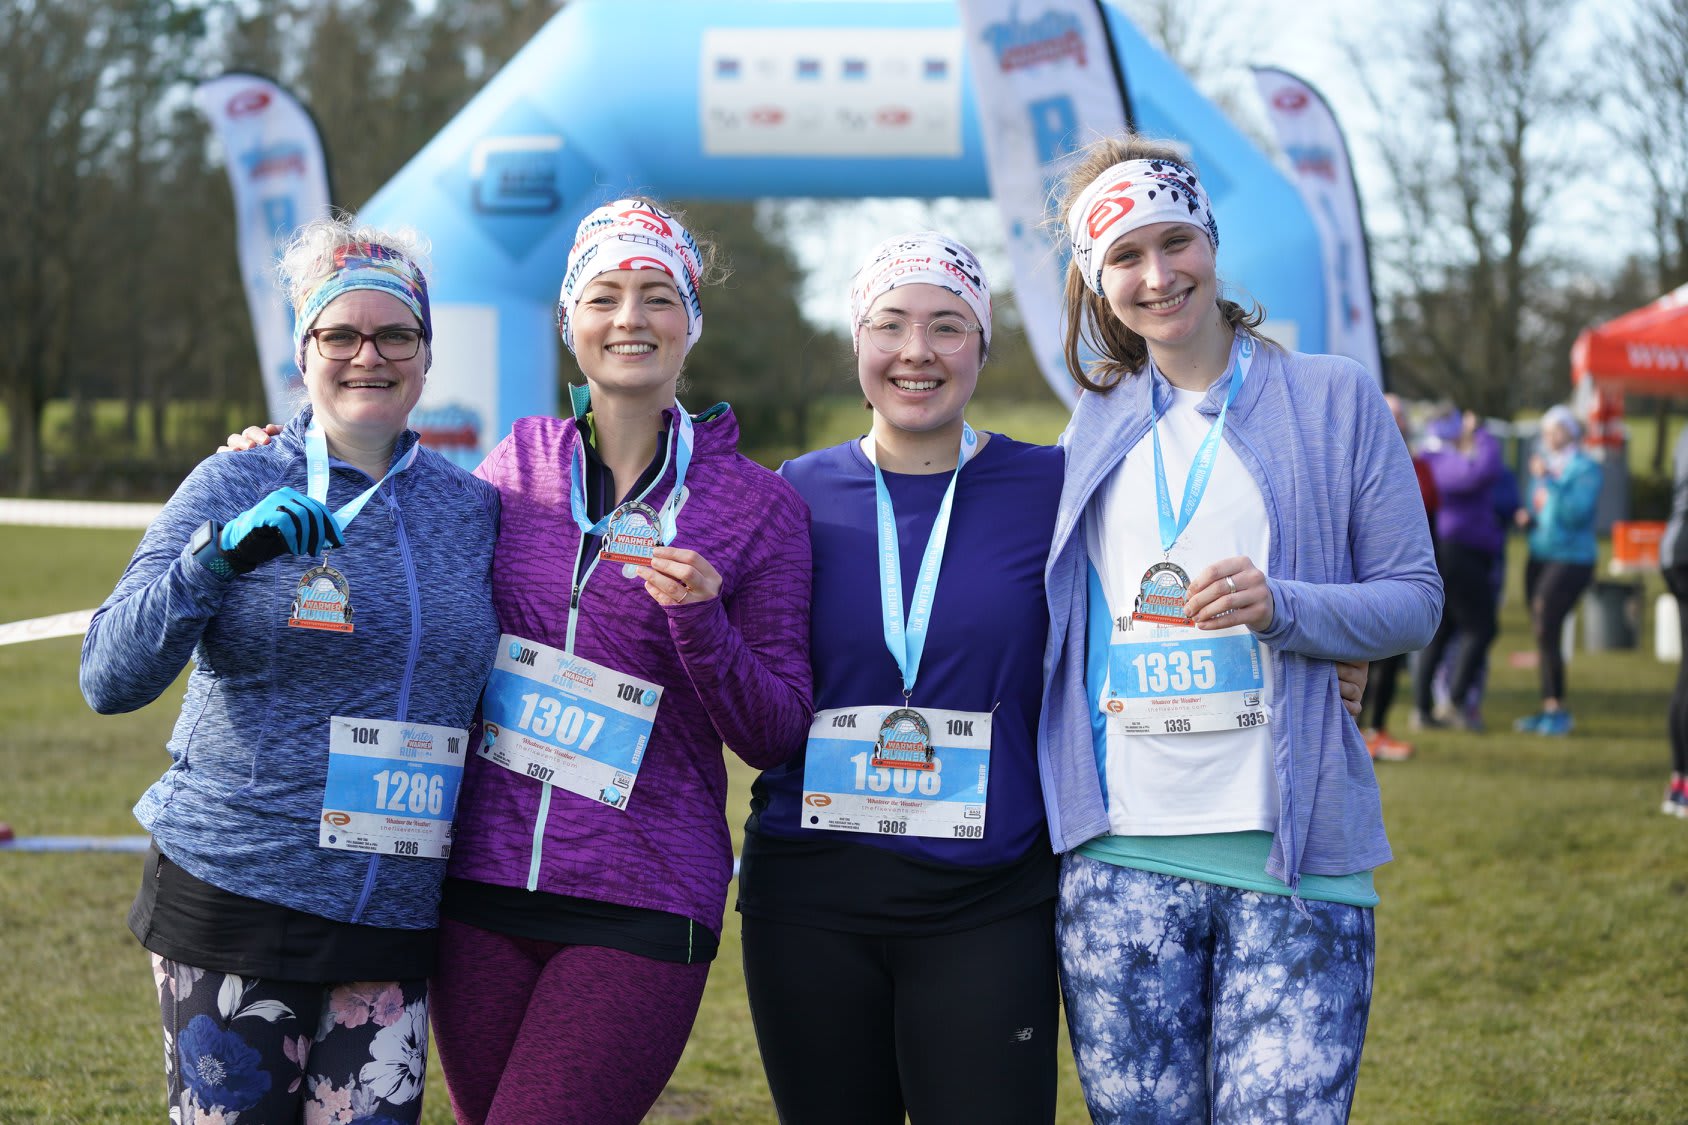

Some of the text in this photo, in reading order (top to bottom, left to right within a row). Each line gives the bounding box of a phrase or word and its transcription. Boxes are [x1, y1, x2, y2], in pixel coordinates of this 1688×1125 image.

[617, 535, 654, 547] WARMER
[881, 502, 900, 634] 10K WINTER WARMER RUNNER 2020
[913, 550, 938, 632] 10K WINTER WARMER
[305, 601, 342, 611] WARMER
[1117, 616, 1134, 632] 10K
[563, 670, 594, 687] WARMER
[1132, 649, 1216, 693] 1335
[617, 682, 645, 705] 10K
[518, 692, 606, 752] 1307
[832, 714, 858, 728] 10K
[946, 719, 974, 737] 10K
[1164, 718, 1191, 733] 1335
[1236, 711, 1265, 728] 1335
[351, 726, 380, 745] 10K
[447, 736, 459, 754] 10K
[631, 734, 647, 766] ABERDEEN
[888, 741, 924, 752] WARMER
[526, 762, 555, 782] 1307
[372, 769, 444, 815] 1286
[598, 788, 627, 809] 17
[877, 819, 907, 834] 1308
[953, 824, 983, 838] 1308
[394, 840, 419, 855] 1286
